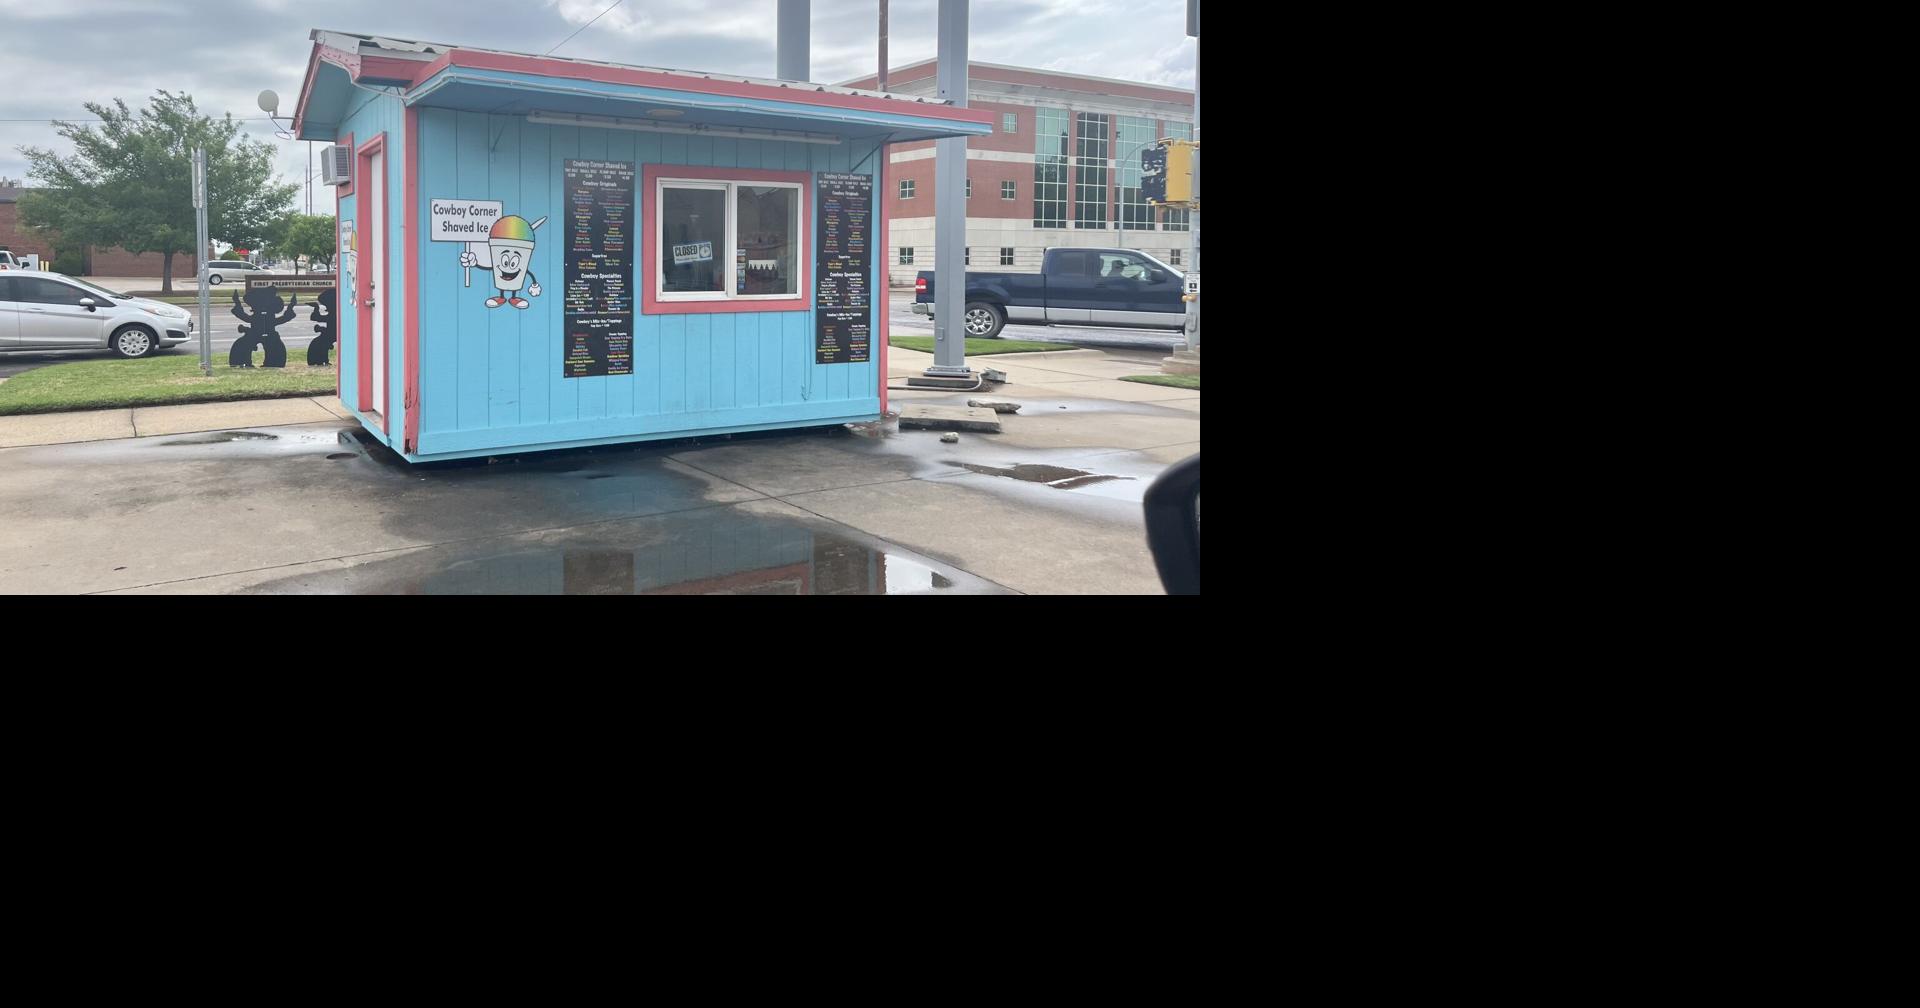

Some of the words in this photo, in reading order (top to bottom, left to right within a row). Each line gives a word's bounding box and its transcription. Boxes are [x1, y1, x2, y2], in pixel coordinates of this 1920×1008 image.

[433, 203, 467, 218] Cowboy
[469, 205, 498, 216] Corner
[442, 220, 475, 233] Shaved
[476, 221, 489, 233] Ice
[674, 245, 698, 257] CLOSED
